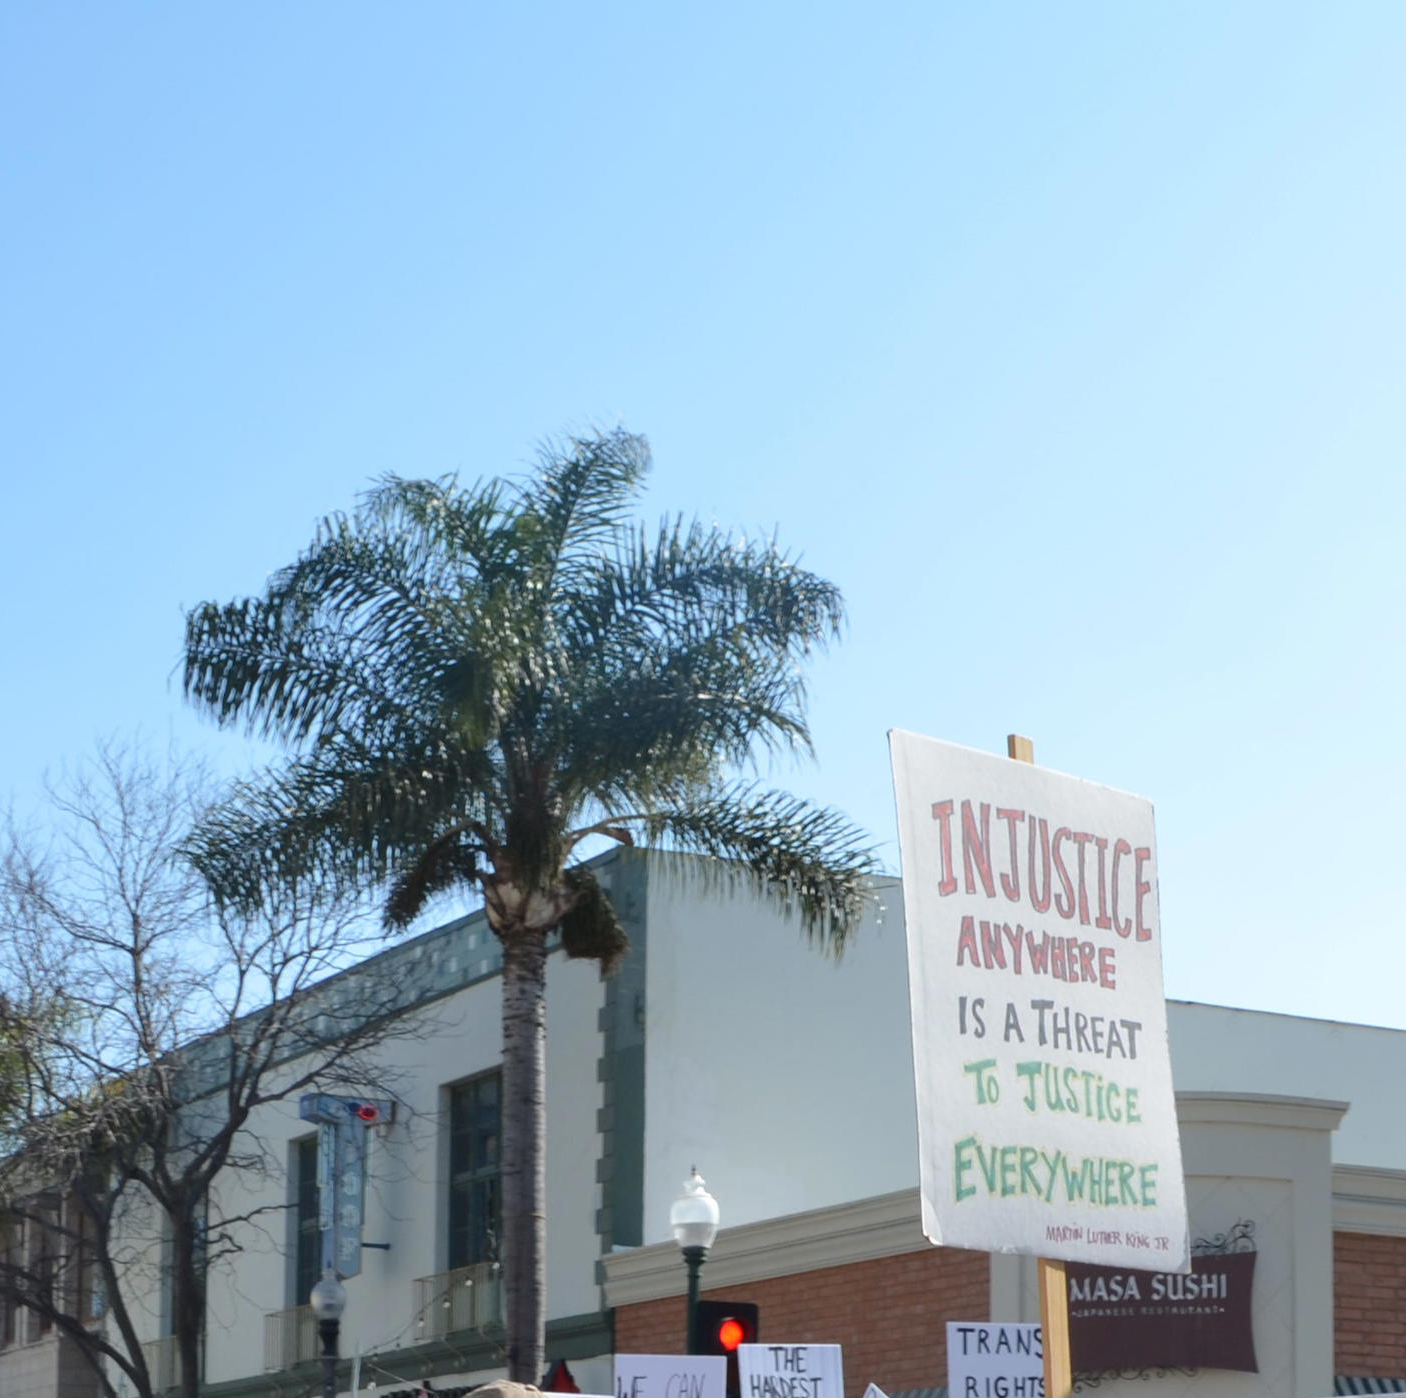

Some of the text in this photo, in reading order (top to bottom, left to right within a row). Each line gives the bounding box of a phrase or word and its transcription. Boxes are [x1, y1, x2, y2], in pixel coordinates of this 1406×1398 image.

[932, 799, 1151, 942] INJUSTICE
[956, 916, 1116, 990] ANYWHERE
[958, 996, 1142, 1059] IS A THREAT
[954, 1136, 1158, 1206] EVERYWHERE
[1070, 1273, 1227, 1301] MASA SUSHI
[769, 1347, 807, 1373] THE
[957, 1328, 1043, 1359] TRANS
